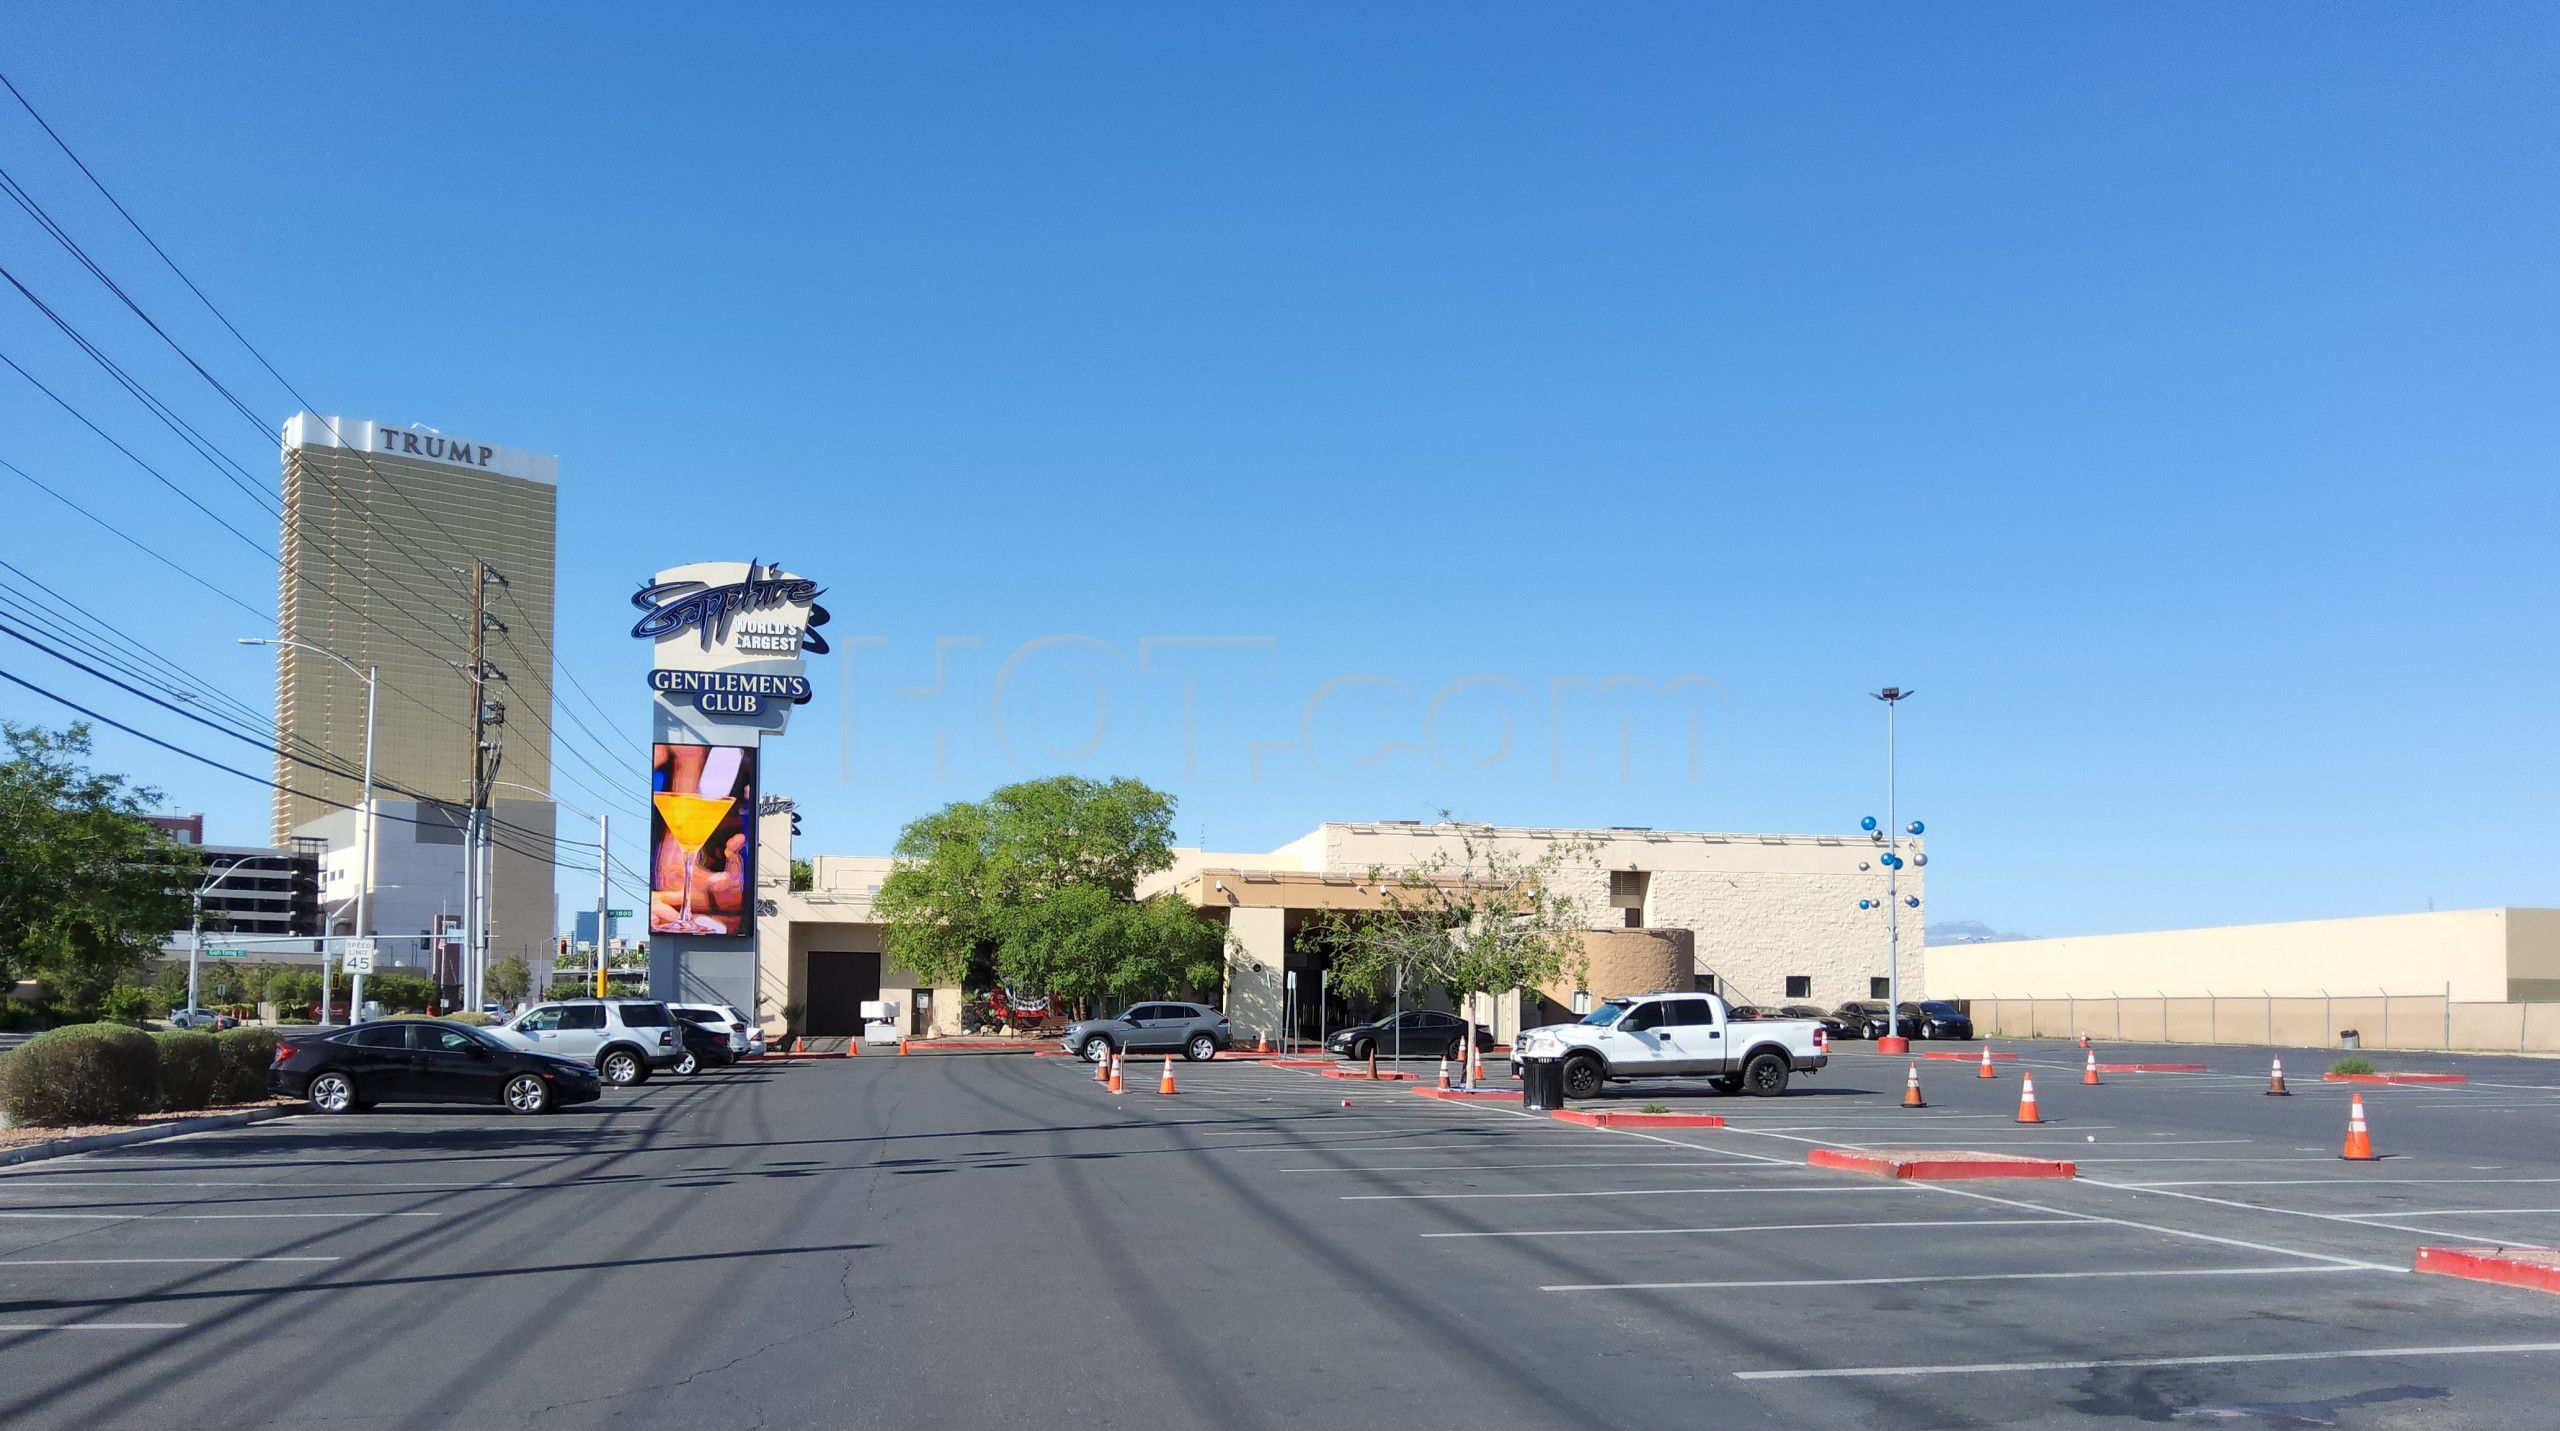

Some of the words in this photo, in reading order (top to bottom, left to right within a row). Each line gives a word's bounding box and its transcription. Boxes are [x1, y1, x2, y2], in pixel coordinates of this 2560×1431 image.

[380, 427, 494, 467] TRUMP
[631, 556, 829, 649] Sapphire
[734, 620, 797, 635] WORLD'S
[734, 635, 797, 651] LARGEST
[654, 671, 804, 695] GENTLEMEN'S
[701, 693, 758, 712] CLUB
[346, 957, 370, 970] 45
